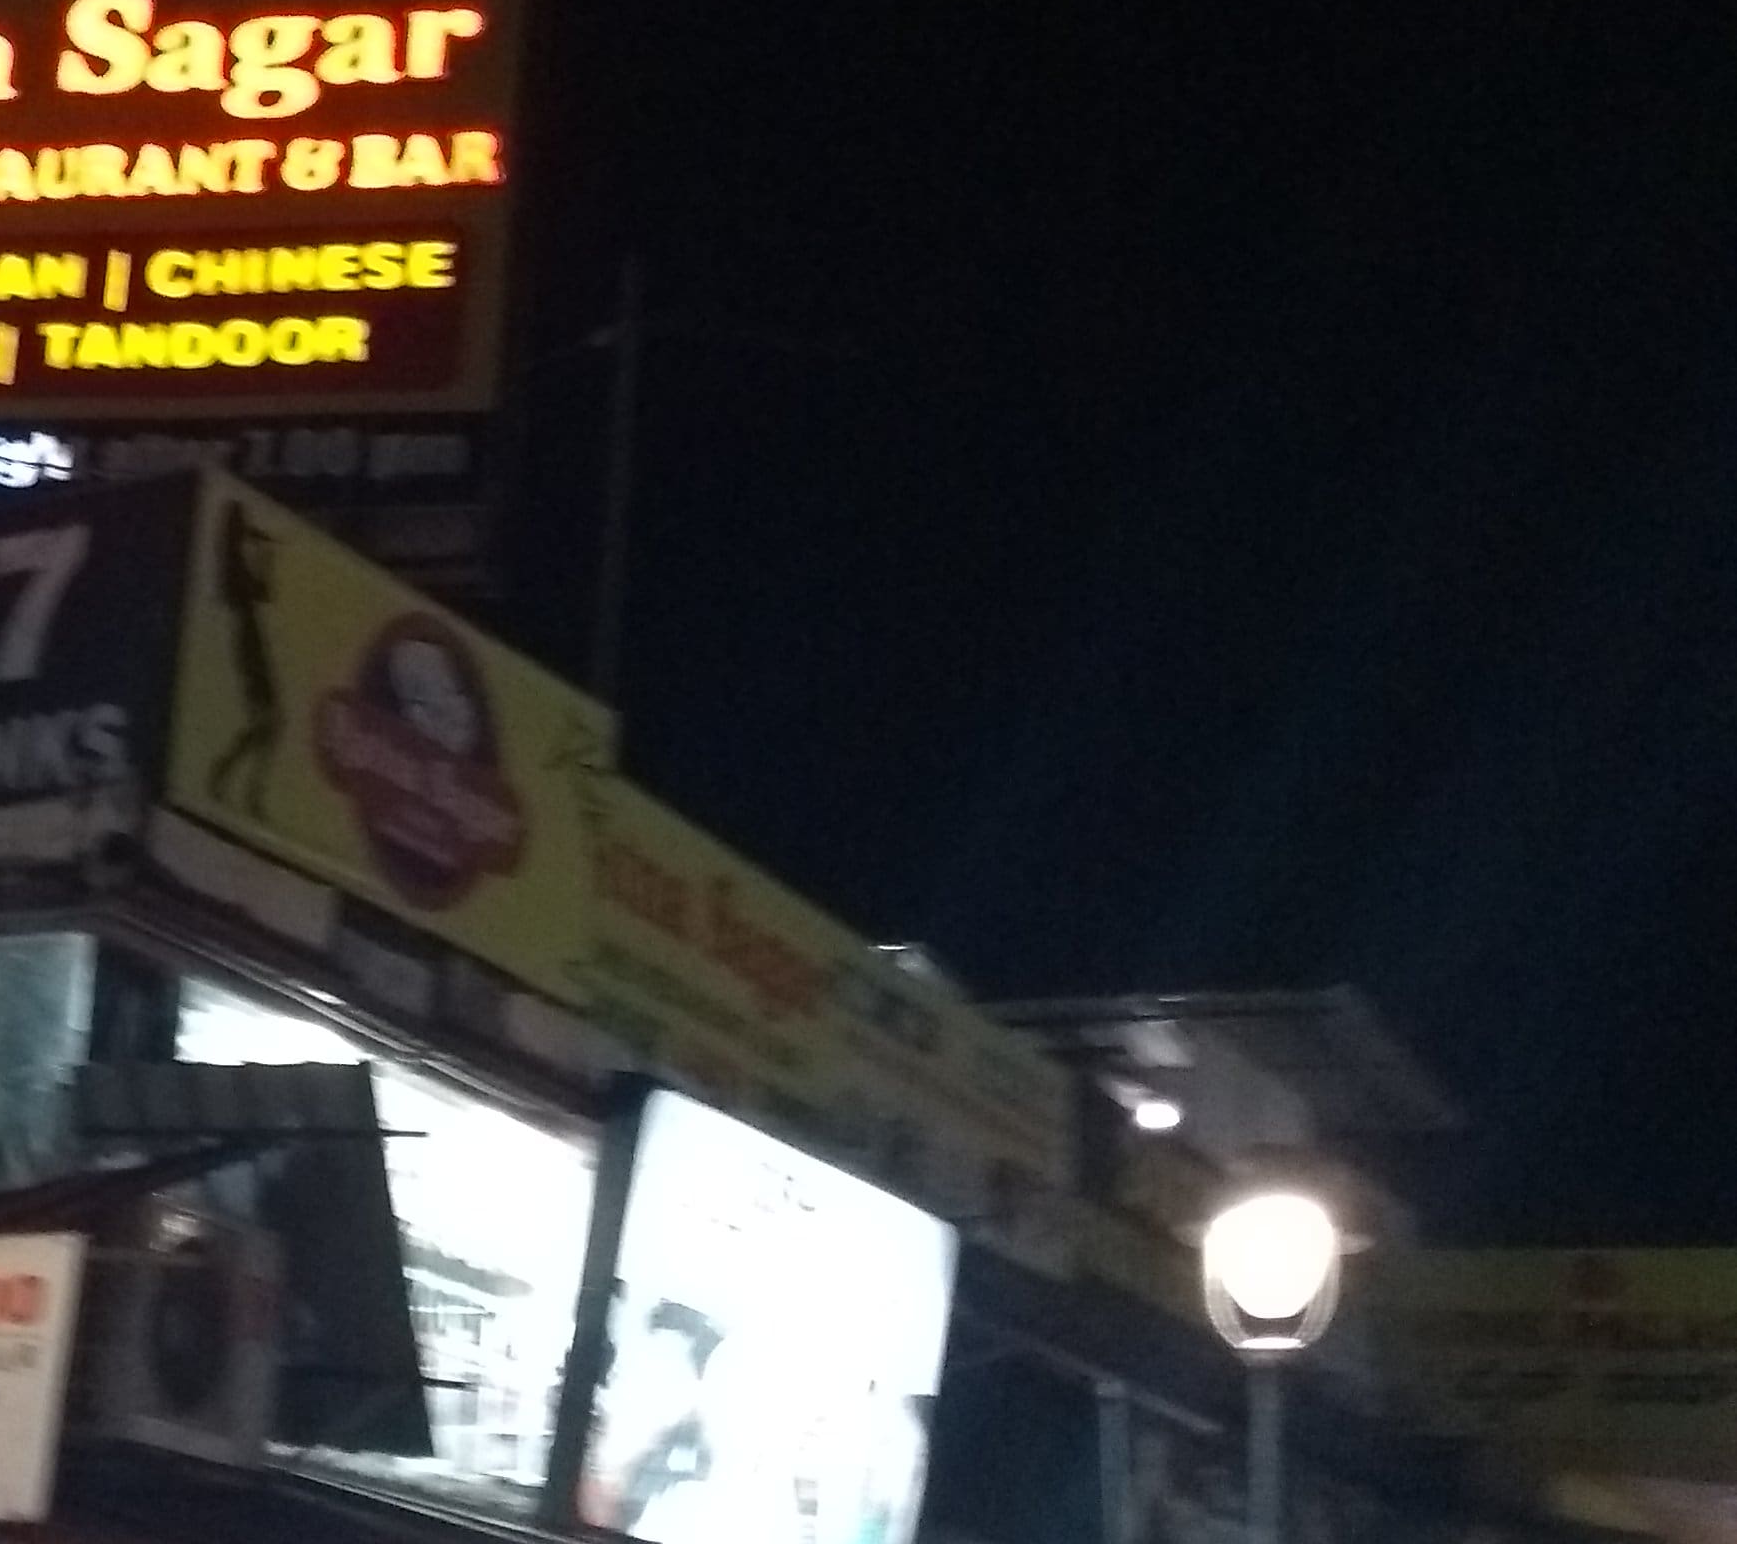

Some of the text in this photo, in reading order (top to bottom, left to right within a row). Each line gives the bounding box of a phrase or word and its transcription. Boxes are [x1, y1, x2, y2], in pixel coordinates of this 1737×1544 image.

[349, 132, 505, 189] BAR
[145, 241, 457, 298] CHINESE
[37, 316, 370, 370] TANDOOR
